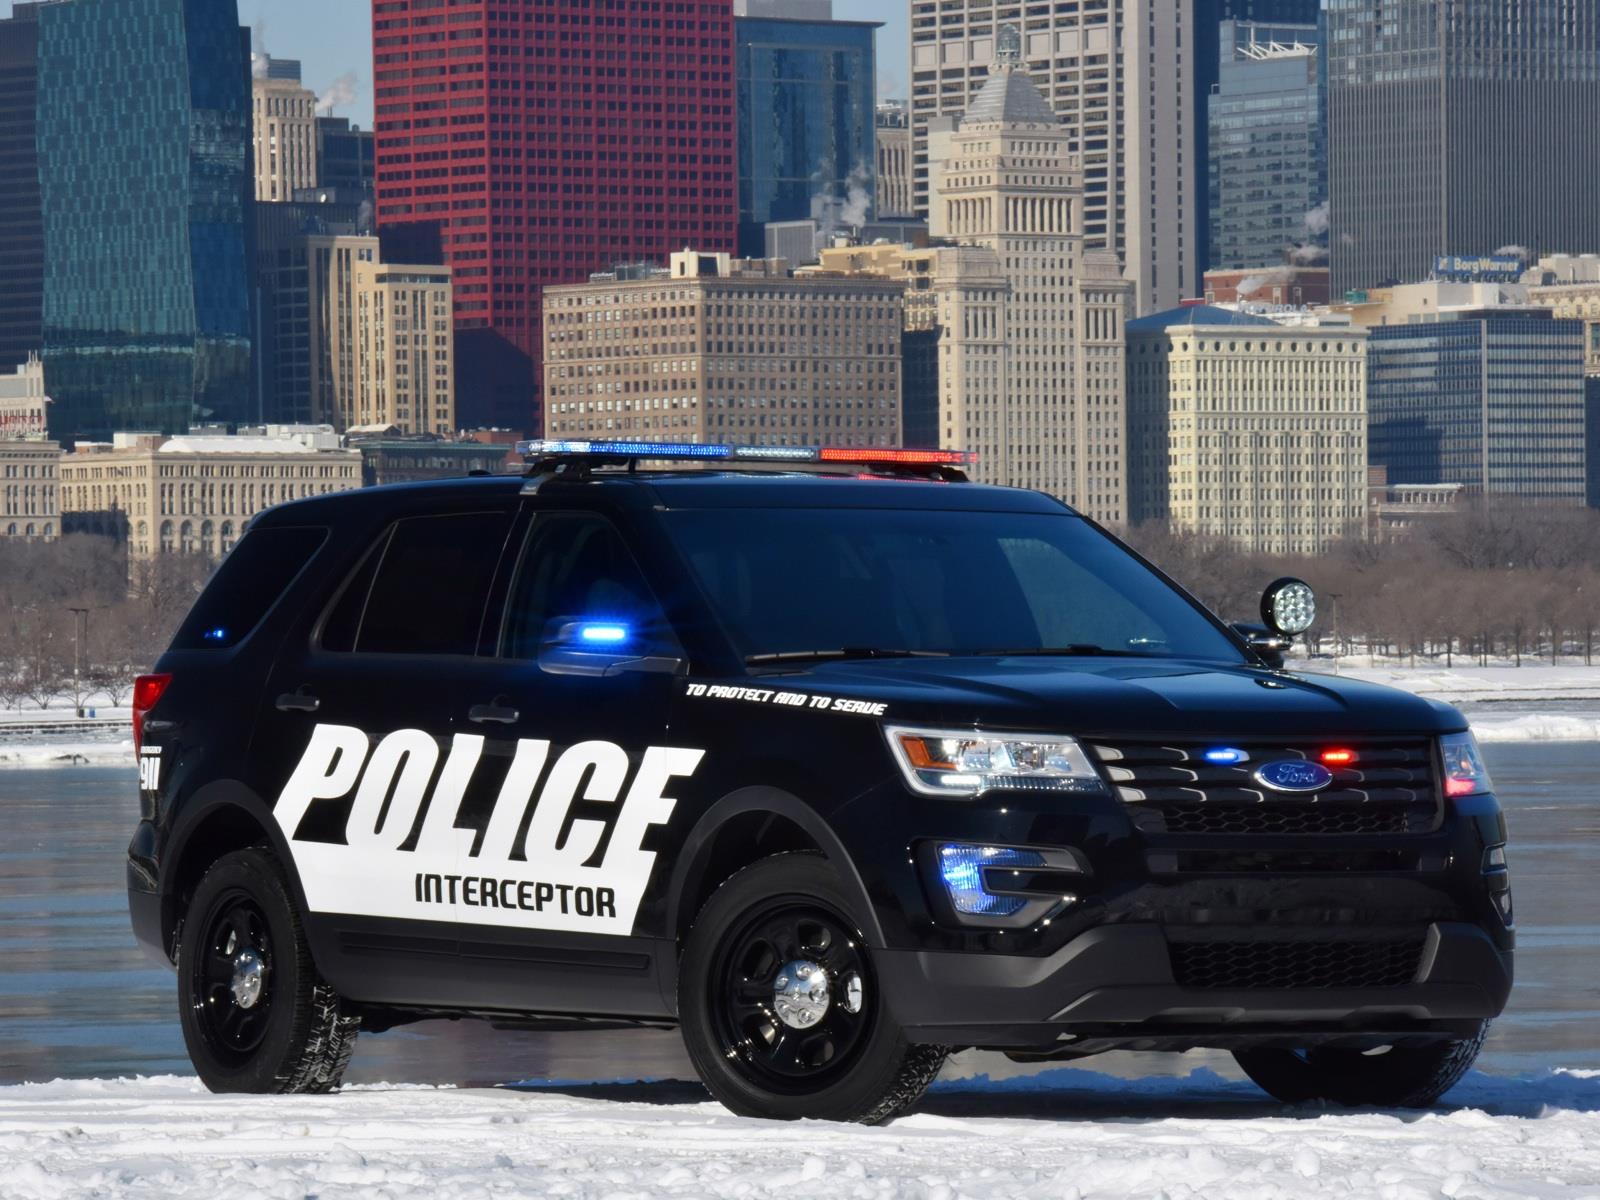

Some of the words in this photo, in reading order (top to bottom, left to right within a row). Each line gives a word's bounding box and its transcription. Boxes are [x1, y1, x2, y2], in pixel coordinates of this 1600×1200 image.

[1454, 257, 1519, 273] BorgWarner
[686, 683, 705, 696] TO
[707, 685, 775, 702] PROTECT
[773, 691, 808, 706] AND
[809, 696, 832, 709] TO
[831, 699, 888, 716] SERVE
[1276, 763, 1318, 783] Ford
[273, 723, 706, 868] POLICE
[415, 873, 616, 918] INTERCEPTOR
